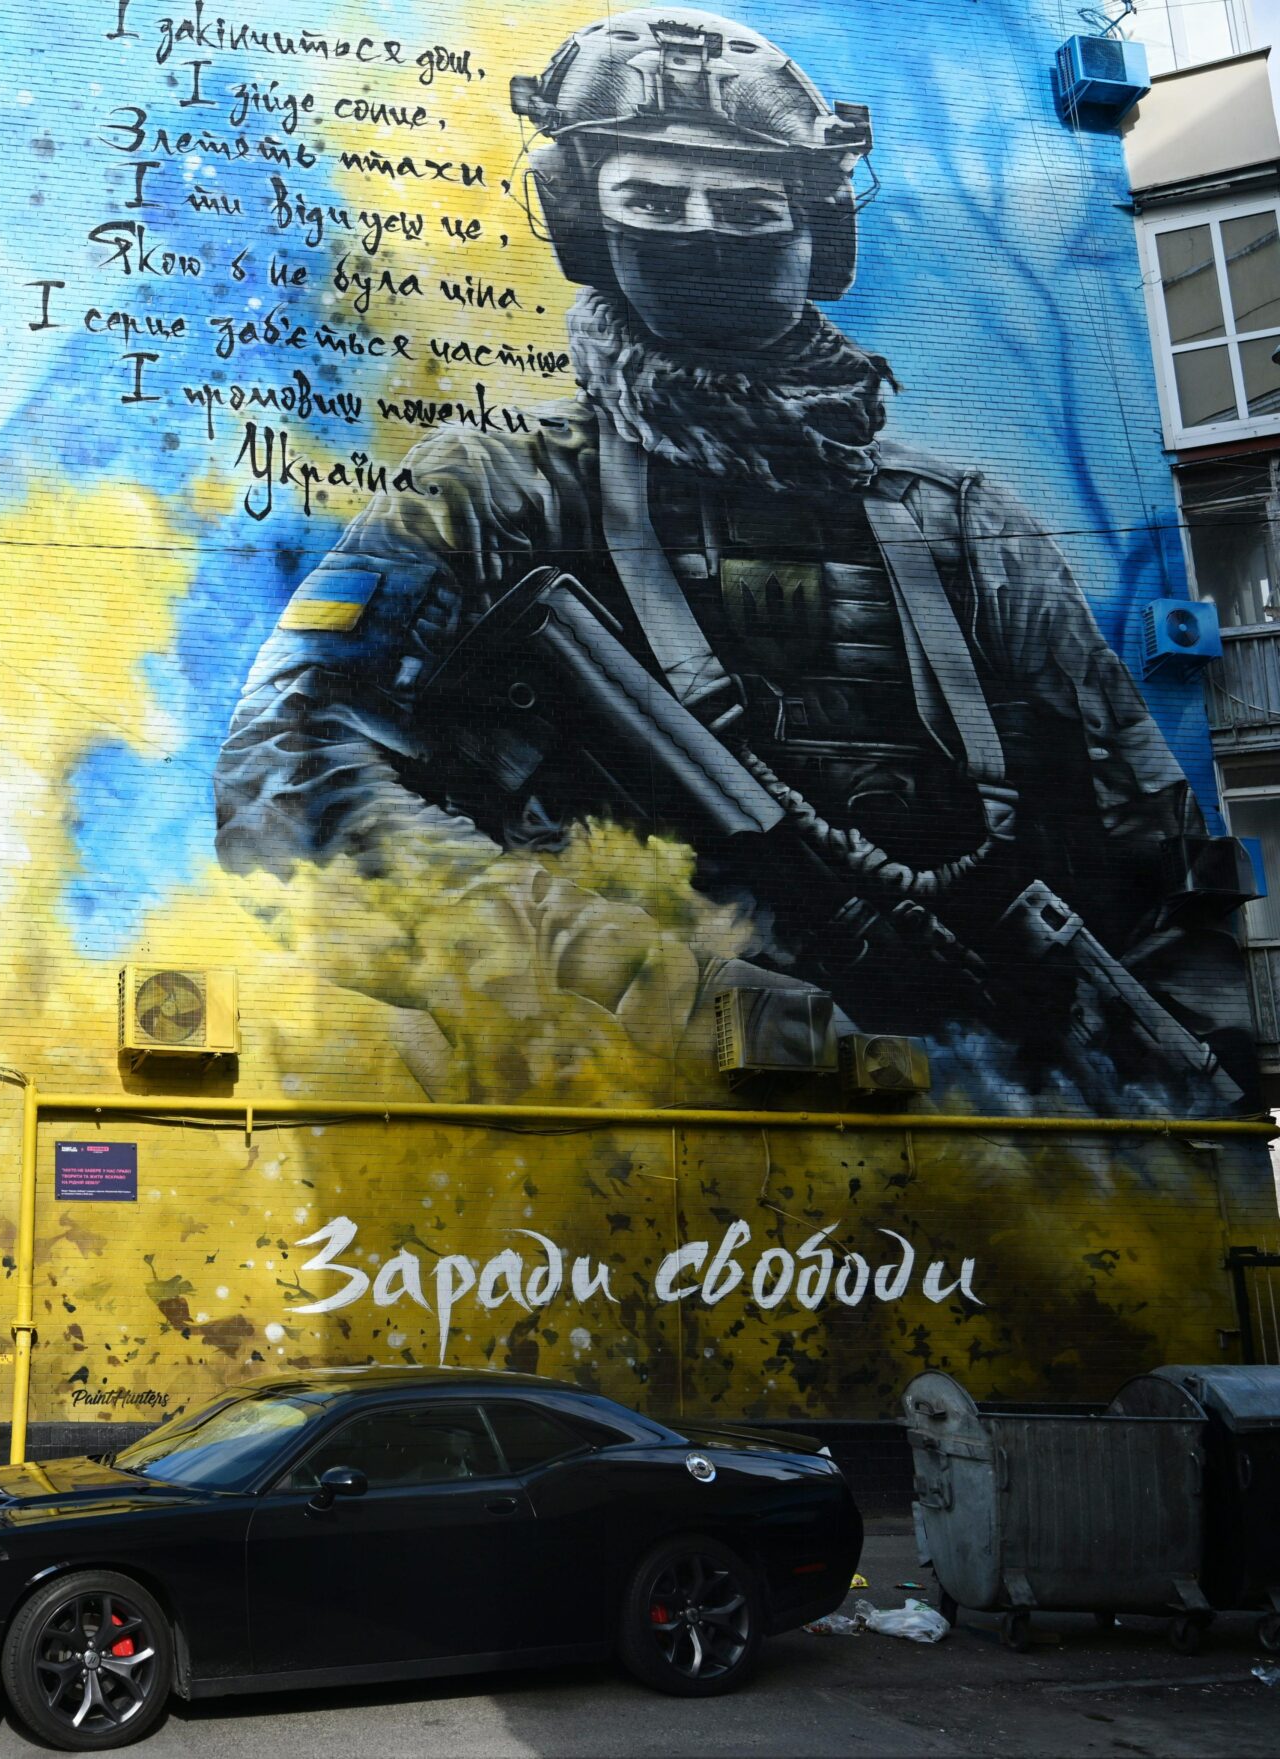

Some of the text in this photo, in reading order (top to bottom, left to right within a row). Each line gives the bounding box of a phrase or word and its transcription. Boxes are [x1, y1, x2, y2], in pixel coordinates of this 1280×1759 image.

[179, 60, 217, 107] І
[122, 161, 162, 210] І
[270, 255, 310, 287] не
[333, 254, 424, 314] була
[28, 280, 66, 331] І
[83, 307, 187, 345] серце
[120, 352, 161, 402] І
[282, 1214, 987, 1367] Заради свободи
